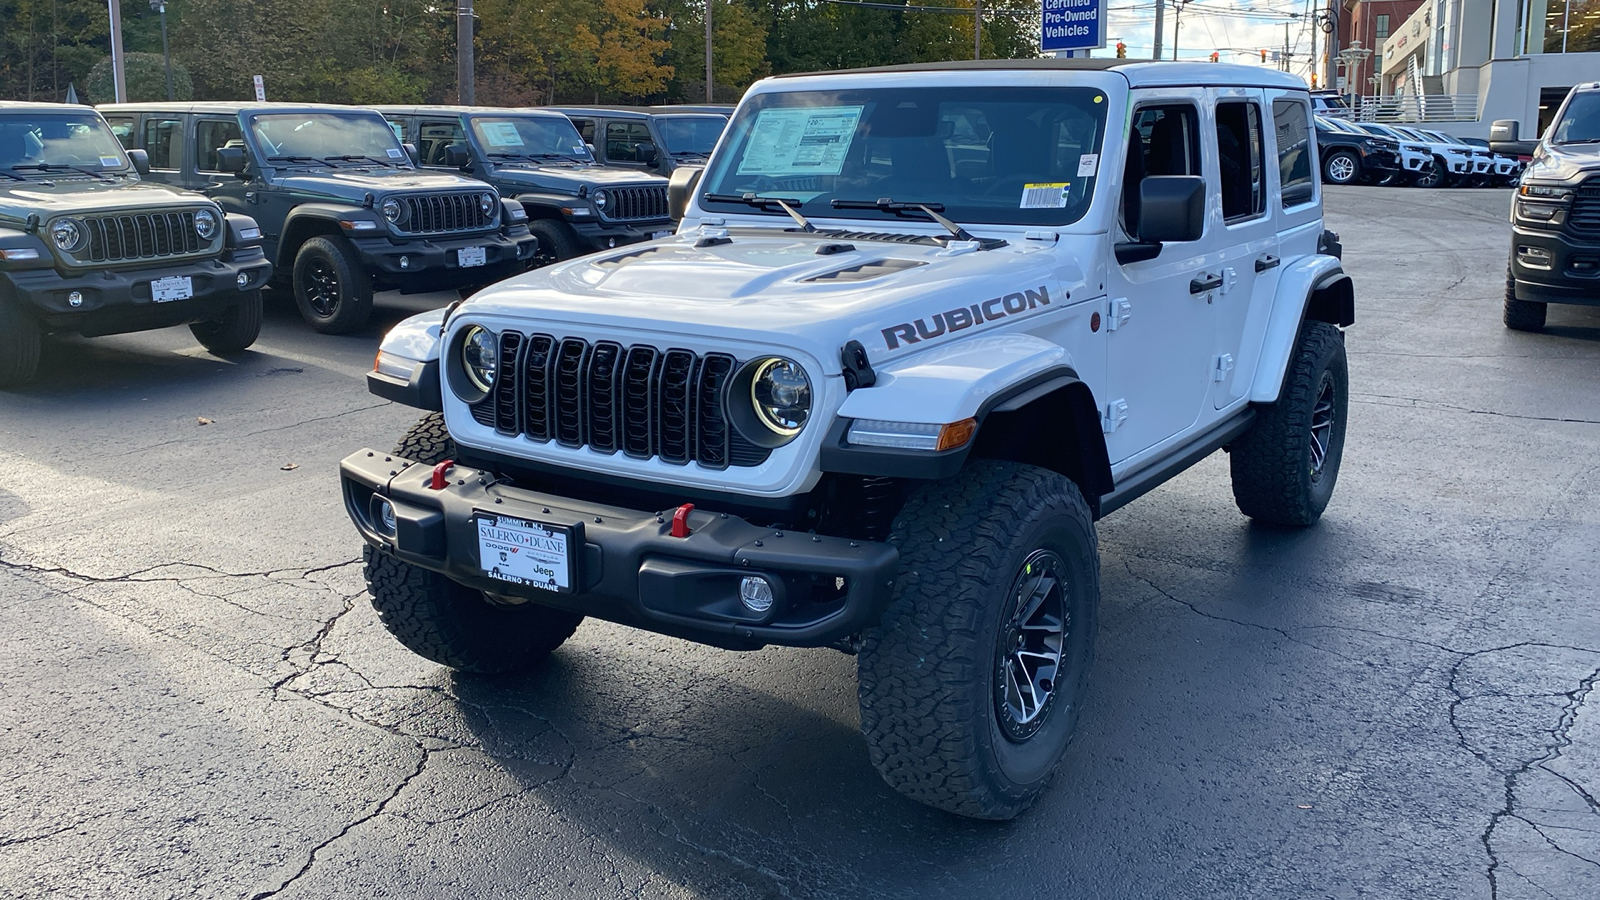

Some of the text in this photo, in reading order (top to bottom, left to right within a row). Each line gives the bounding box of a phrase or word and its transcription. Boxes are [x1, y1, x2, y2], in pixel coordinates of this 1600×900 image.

[1046, 0, 1090, 9] Certified
[1045, 8, 1097, 24] Pre-Owned
[1045, 25, 1089, 38] Vehicles
[881, 285, 1051, 350] RUBICON
[532, 522, 543, 531] NJ
[480, 527, 564, 553] SALERNO DUANE
[533, 564, 554, 577] Jeep
[487, 571, 559, 592] SALERNO DUANE
